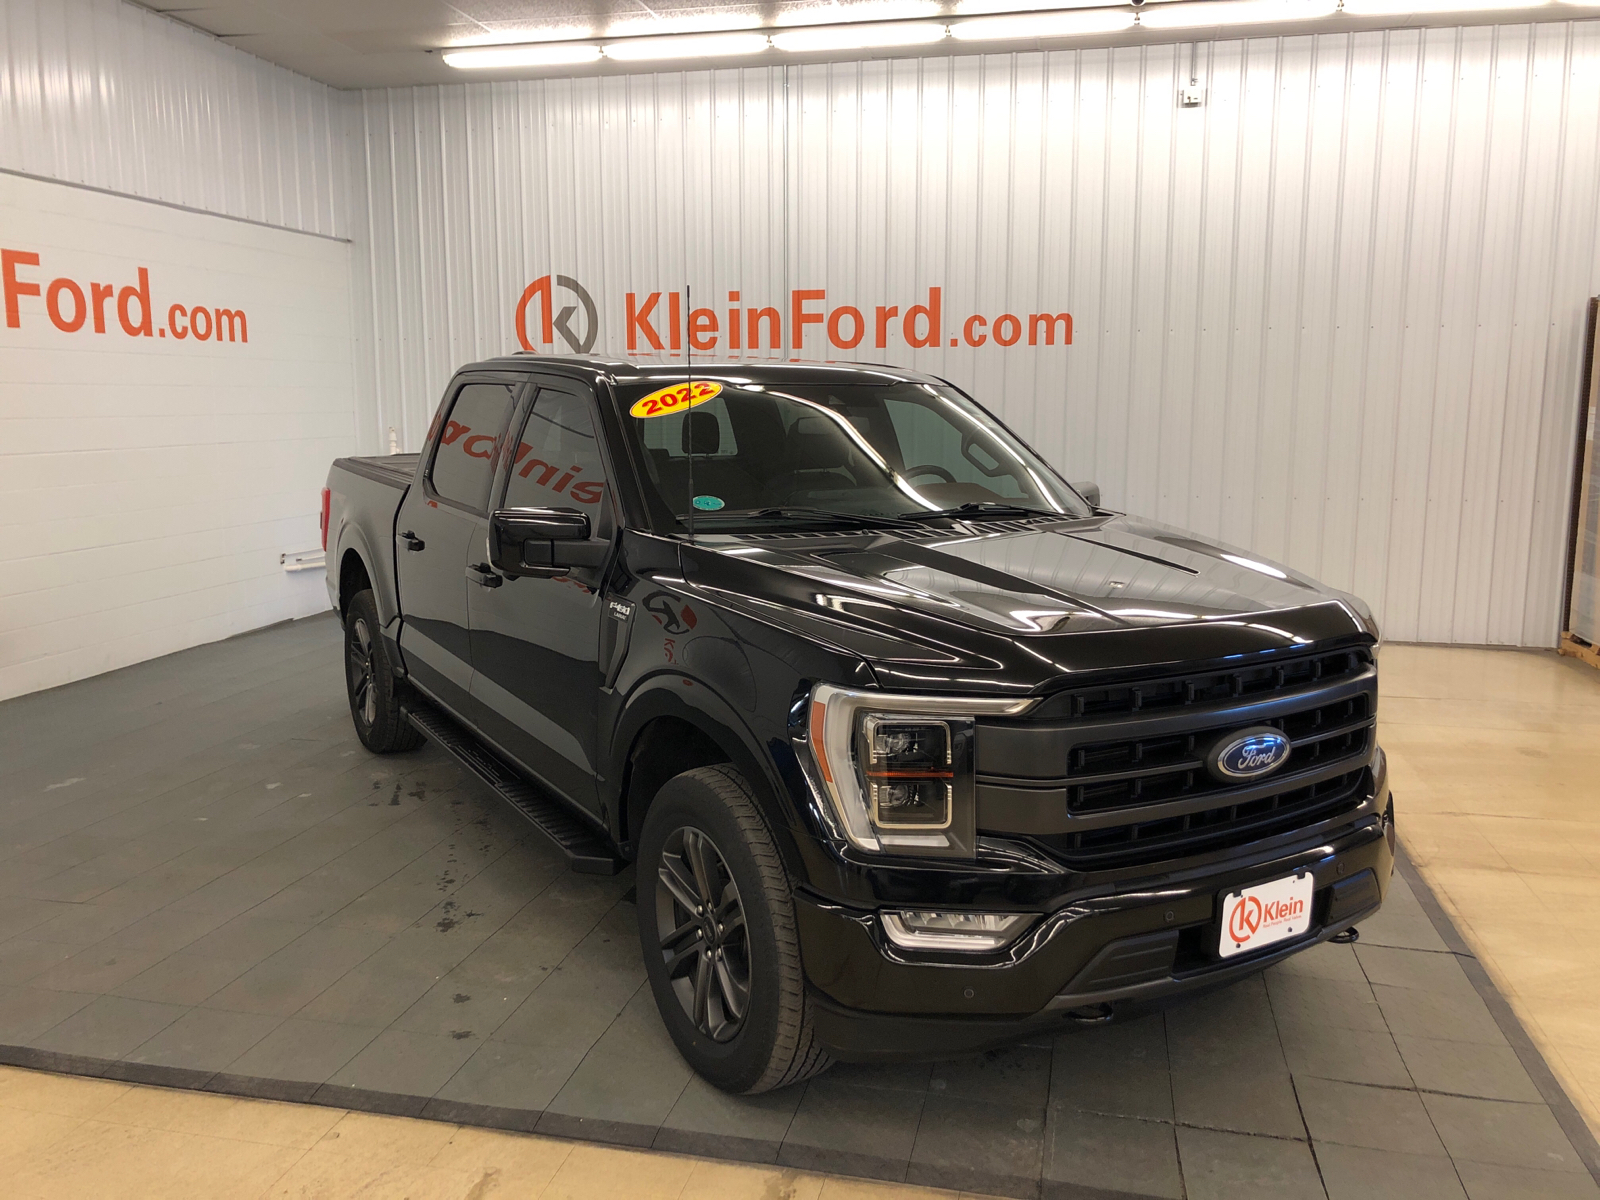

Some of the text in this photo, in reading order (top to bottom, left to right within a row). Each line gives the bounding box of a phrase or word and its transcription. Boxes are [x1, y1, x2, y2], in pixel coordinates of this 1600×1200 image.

[1, 248, 249, 343] Ford.com
[625, 286, 1074, 351] KleinFord.com
[642, 382, 715, 416] 2022
[1237, 746, 1276, 769] Ford
[1263, 896, 1304, 922] Klein
